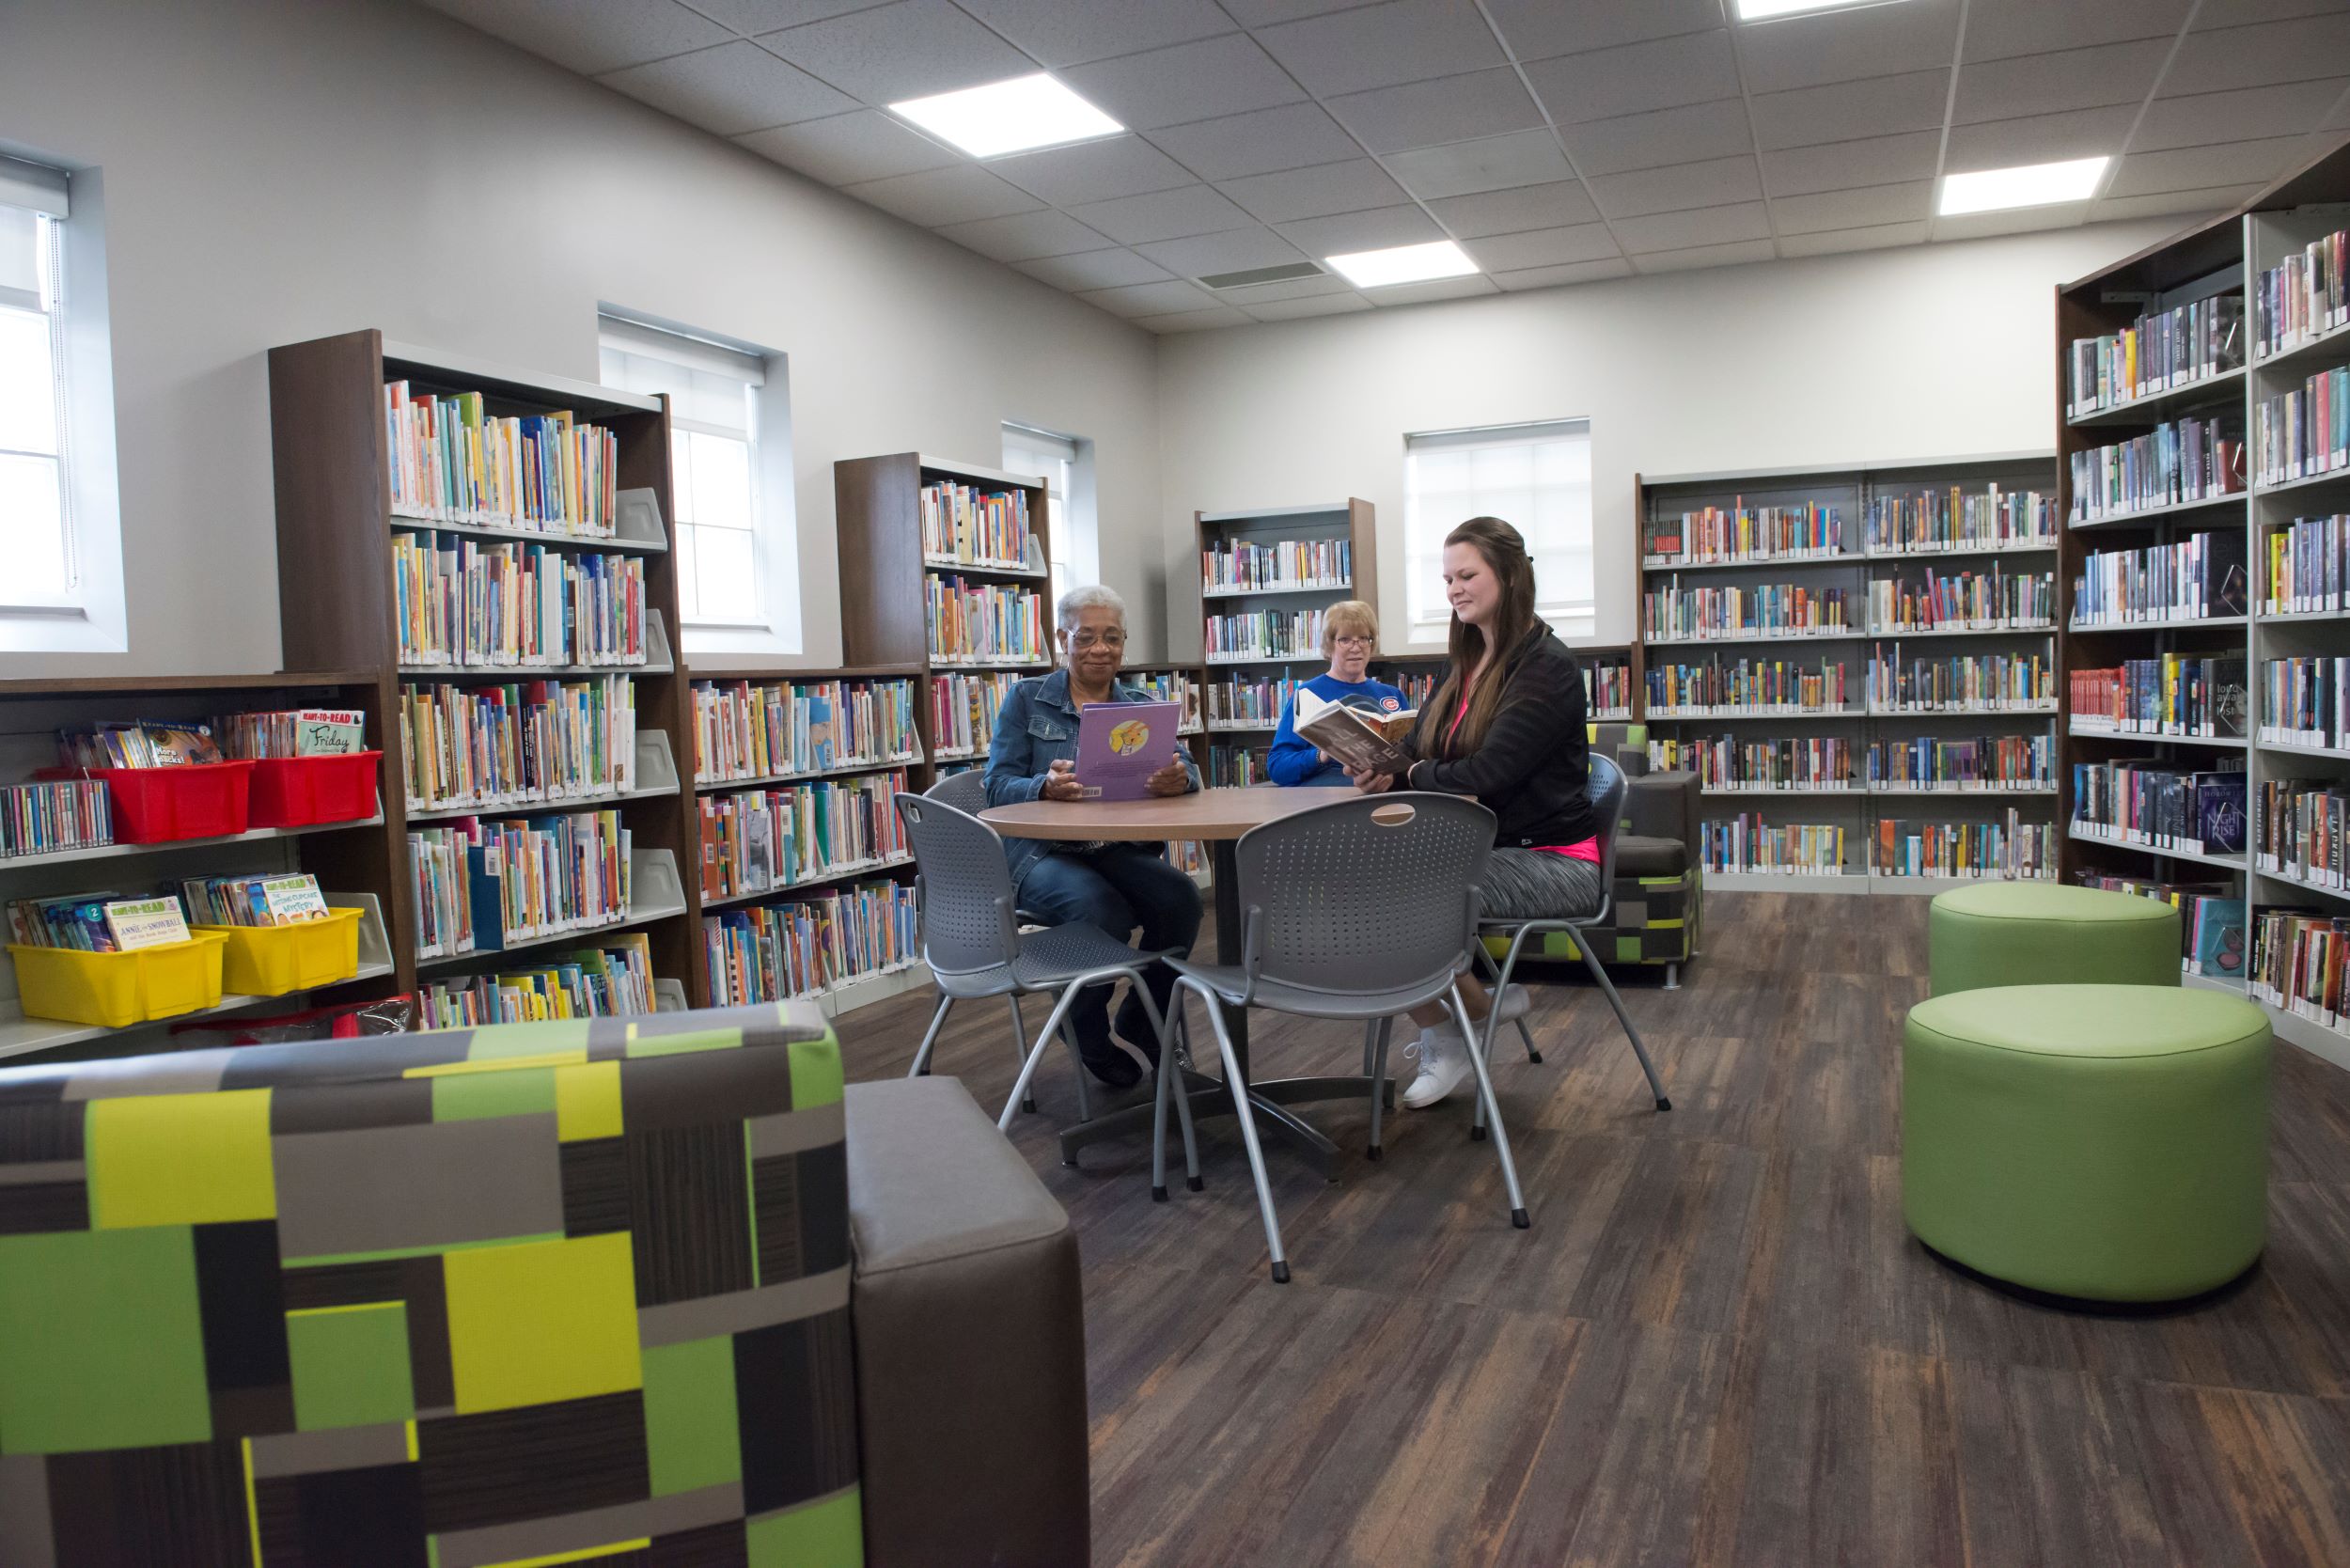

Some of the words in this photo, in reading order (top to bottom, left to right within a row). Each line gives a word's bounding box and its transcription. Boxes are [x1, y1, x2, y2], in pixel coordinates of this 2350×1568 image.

[309, 726, 350, 753] Friday
[1341, 739, 1374, 756] THE
[90, 907, 99, 917] 2
